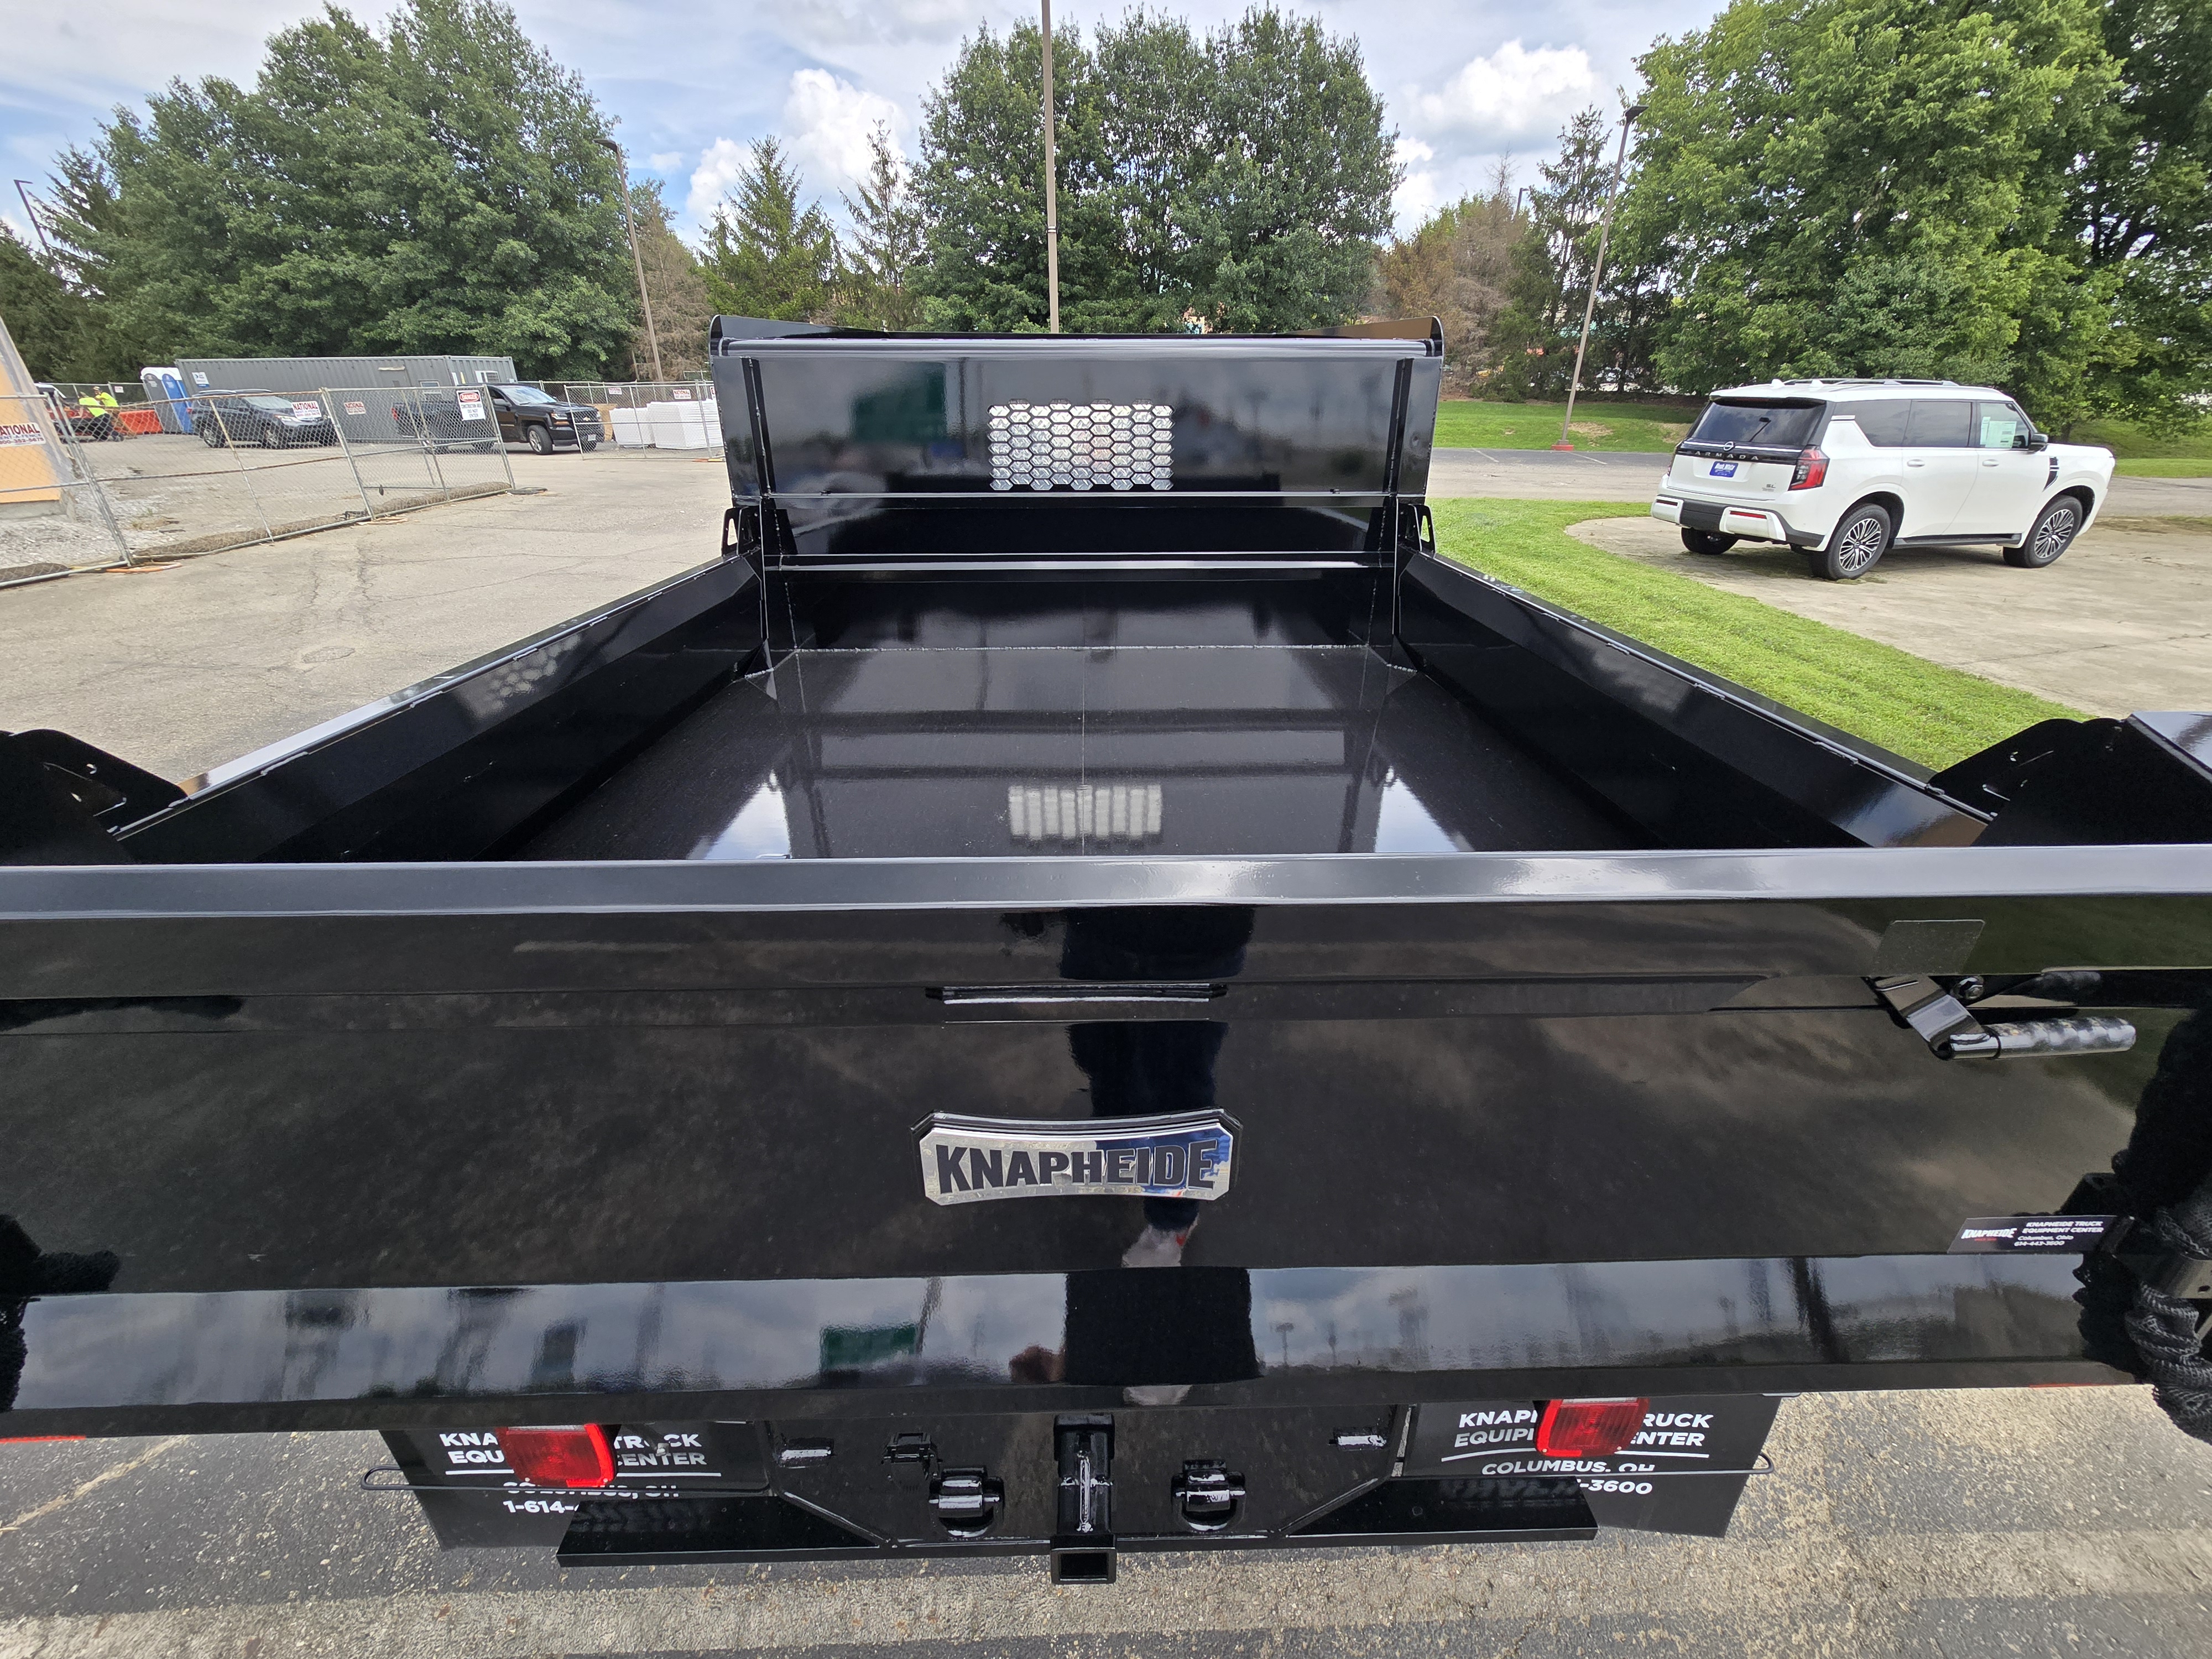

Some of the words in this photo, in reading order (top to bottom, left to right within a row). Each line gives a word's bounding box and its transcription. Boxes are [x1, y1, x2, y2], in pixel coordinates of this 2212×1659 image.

[0, 424, 40, 436] ATIONAL
[1695, 451, 1759, 461] ARMADA
[936, 1139, 1217, 1194] KNAPHEIDE
[1961, 1228, 2017, 1239] KNAPHEIDE
[1643, 1413, 1714, 1428] RUCK
[614, 1434, 702, 1449] TRCK
[1630, 1432, 1705, 1446] NTER
[617, 1452, 707, 1466] ENTER
